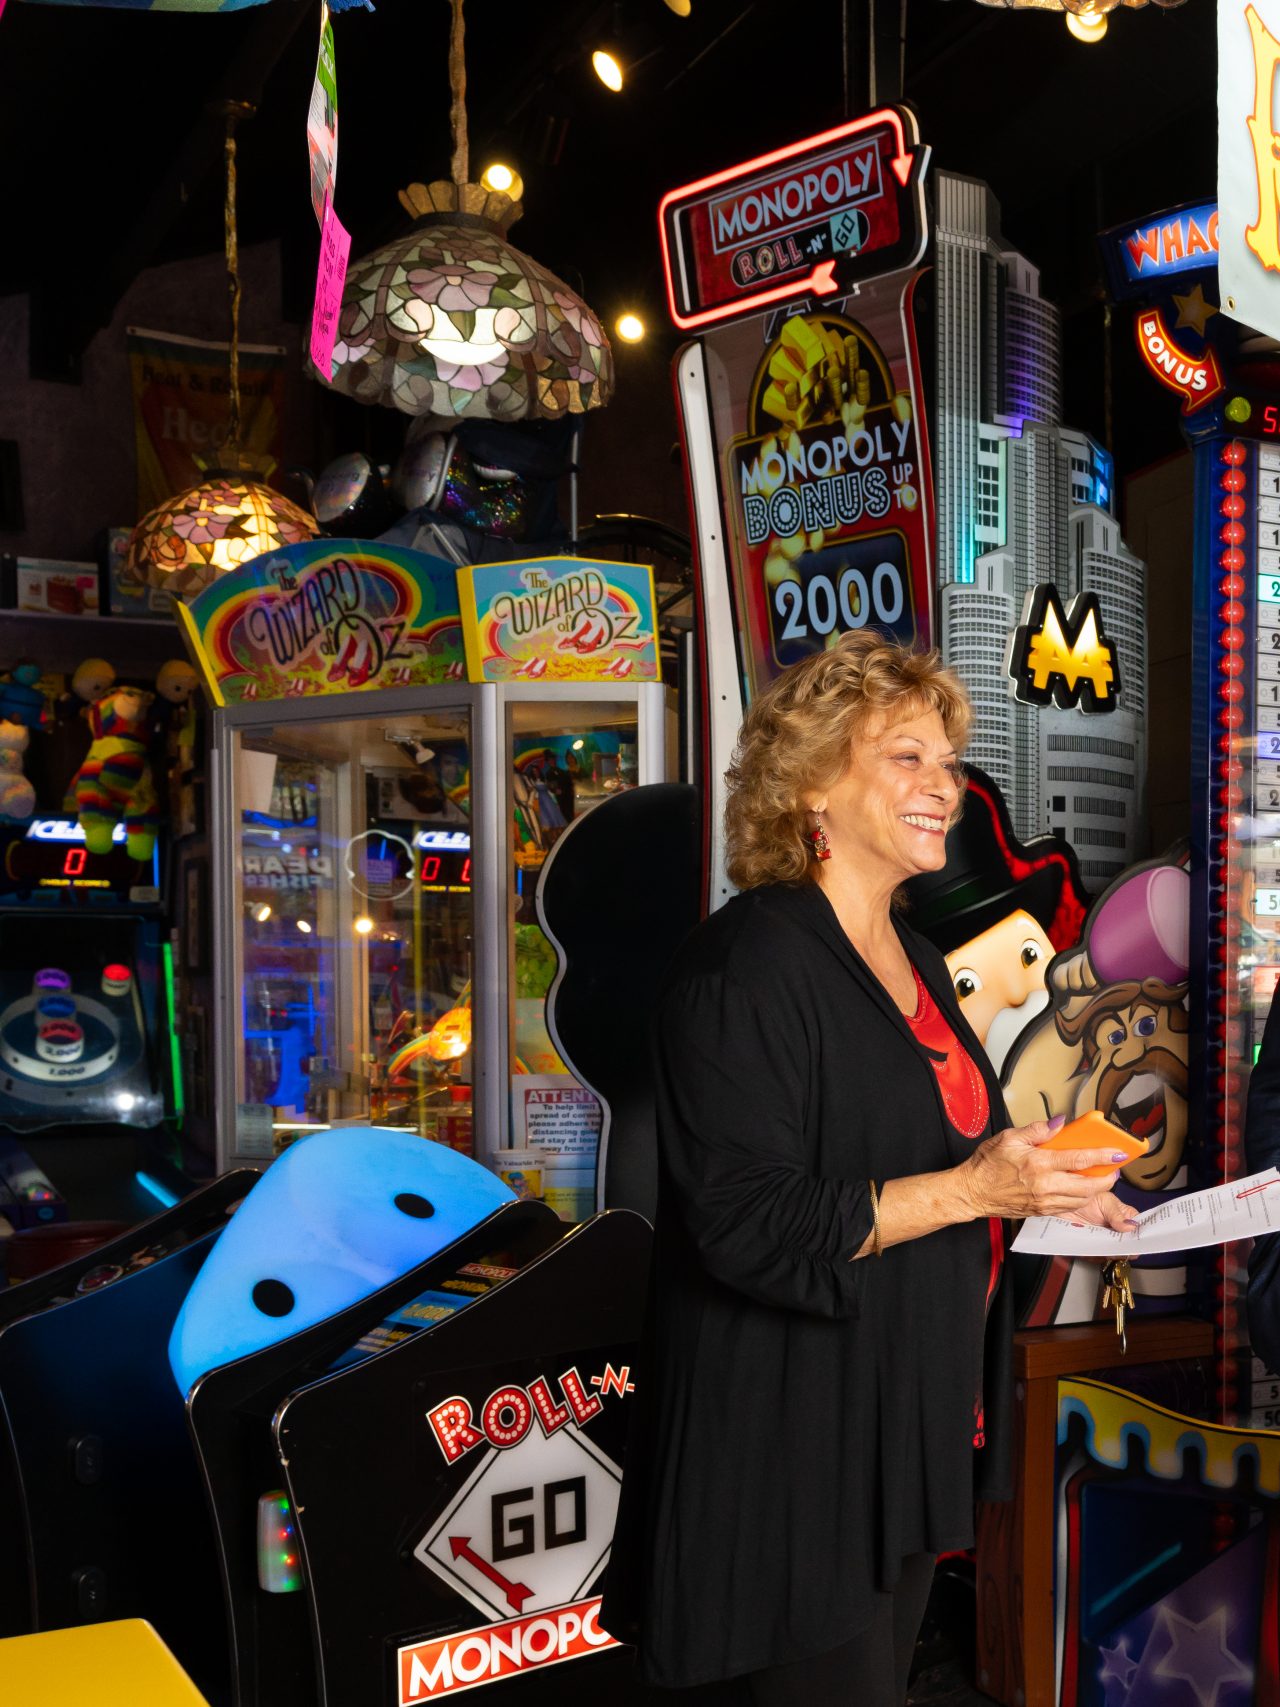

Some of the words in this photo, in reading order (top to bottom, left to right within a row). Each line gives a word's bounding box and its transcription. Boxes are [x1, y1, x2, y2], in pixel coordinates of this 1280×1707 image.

[718, 152, 873, 242] MONOPOLY
[737, 236, 803, 283] ROLL
[835, 213, 855, 248] GO
[1143, 321, 1207, 391] BONUS
[741, 419, 910, 494] MONOPOLY
[743, 467, 890, 544] BONUS
[893, 463, 913, 485] UP
[893, 485, 917, 509] TO
[271, 565, 298, 592] The
[525, 572, 548, 589] The
[249, 558, 361, 665] WIZARD
[495, 571, 604, 636] WIZARD
[775, 562, 904, 640] 2000
[557, 615, 572, 633] of
[320, 627, 337, 657] of
[64, 848, 87, 875] 0
[421, 857, 441, 881] 0
[530, 1112, 559, 1120] spread
[555, 1104, 574, 1112] help
[528, 1120, 556, 1128] please
[1270, 1385, 1279, 1399] 5
[425, 1366, 605, 1466] ROLL
[491, 1475, 587, 1563] GO
